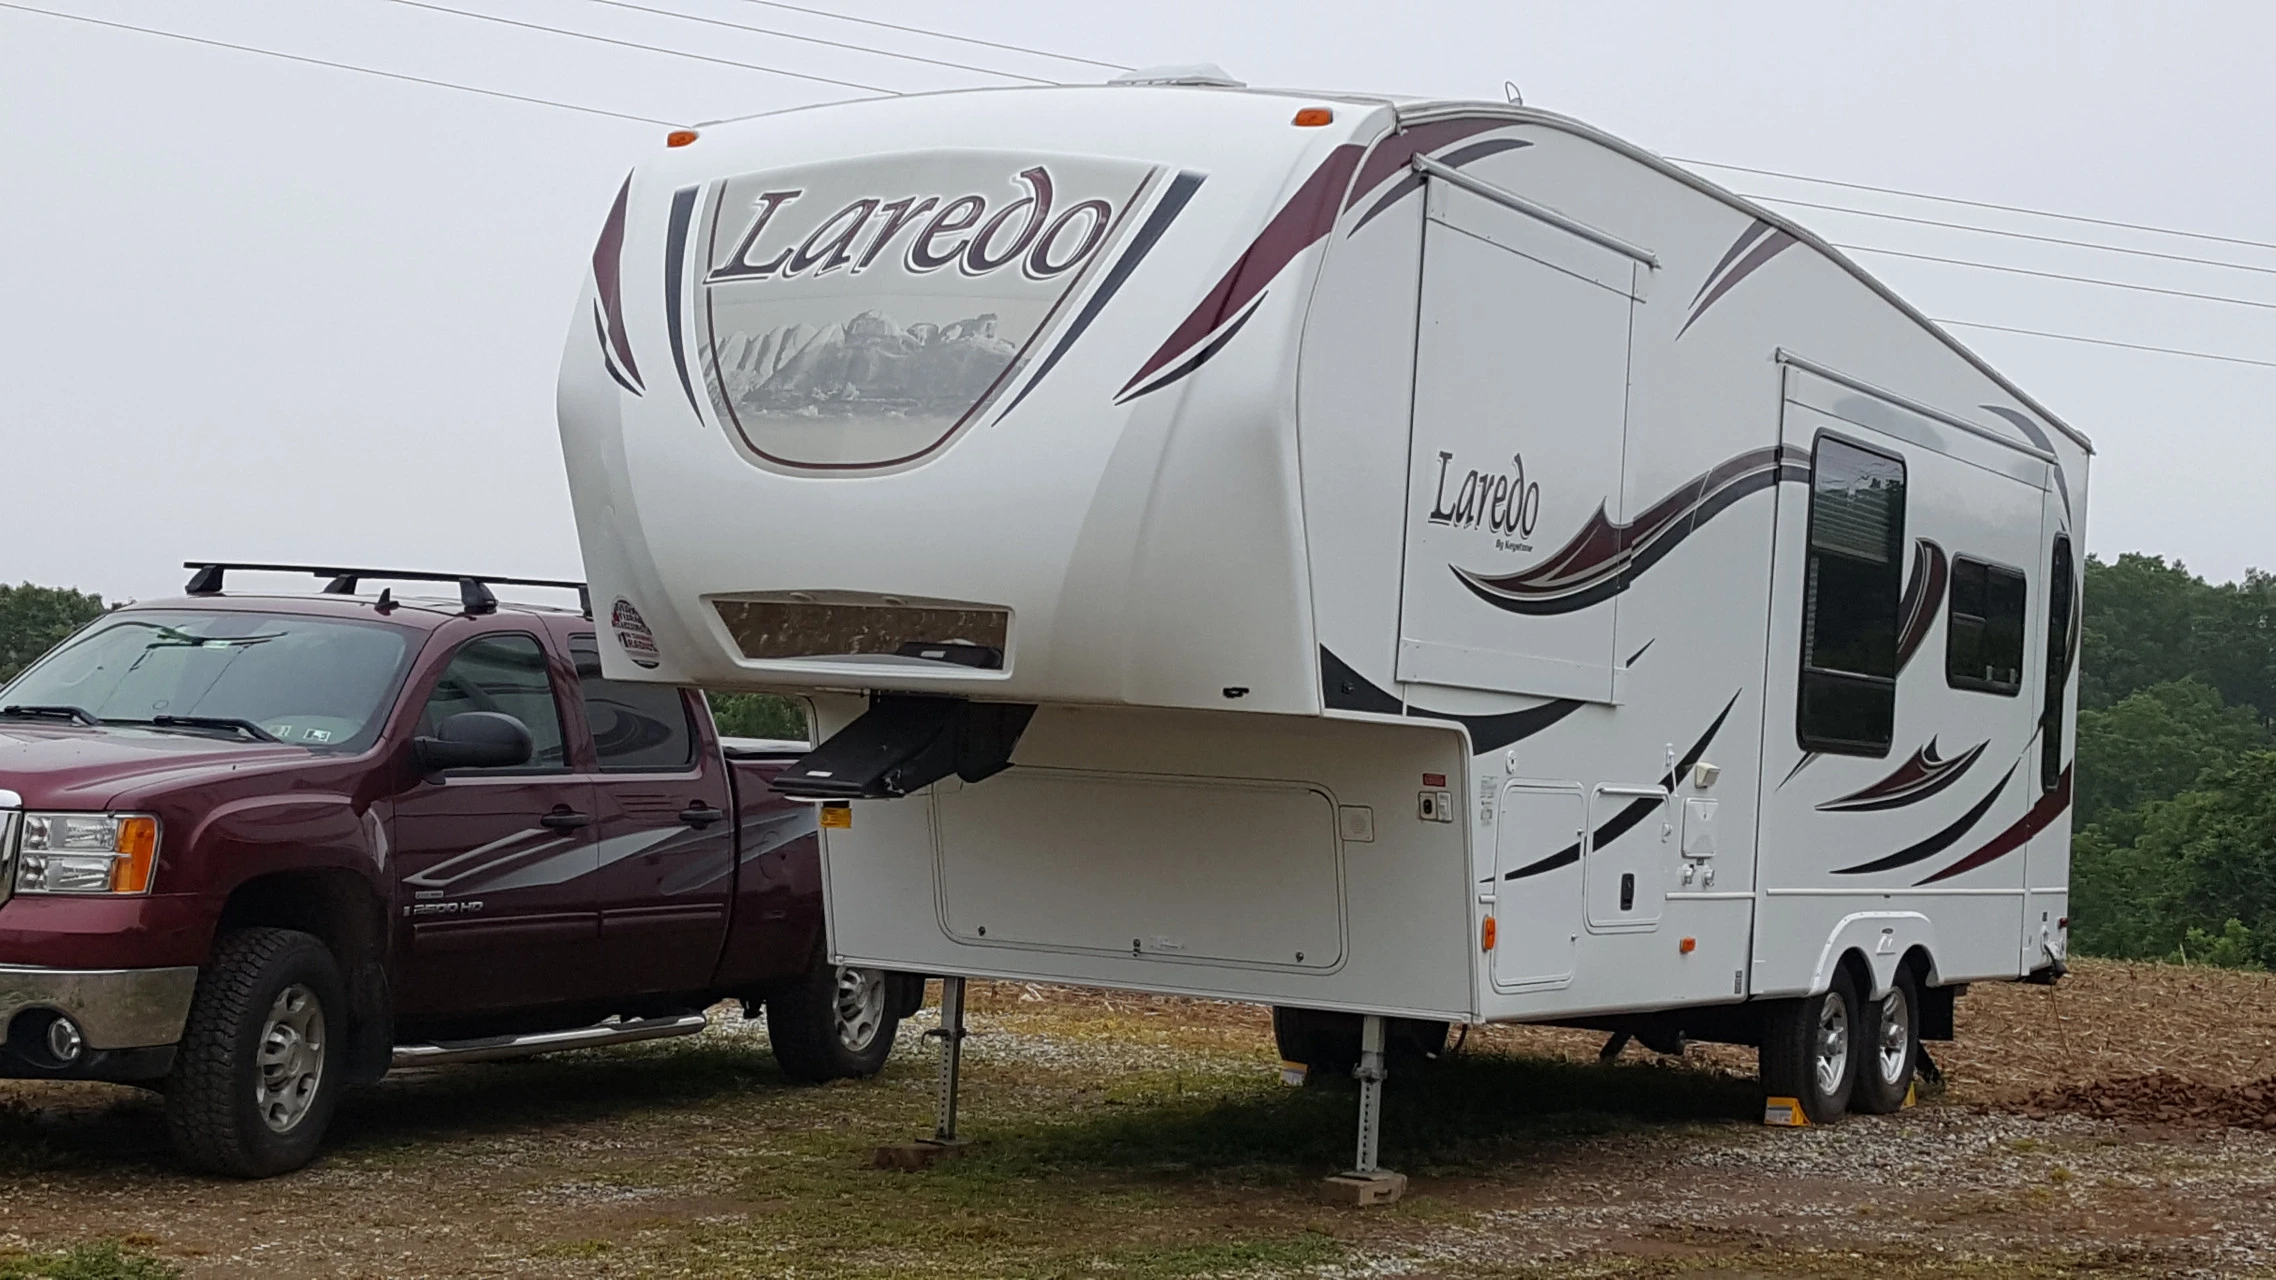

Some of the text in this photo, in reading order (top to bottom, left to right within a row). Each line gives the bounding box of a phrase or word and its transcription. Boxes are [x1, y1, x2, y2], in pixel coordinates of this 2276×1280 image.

[702, 166, 1112, 285] Laredo
[1428, 451, 1540, 540] Laredo
[413, 901, 483, 915] 2500 HD
